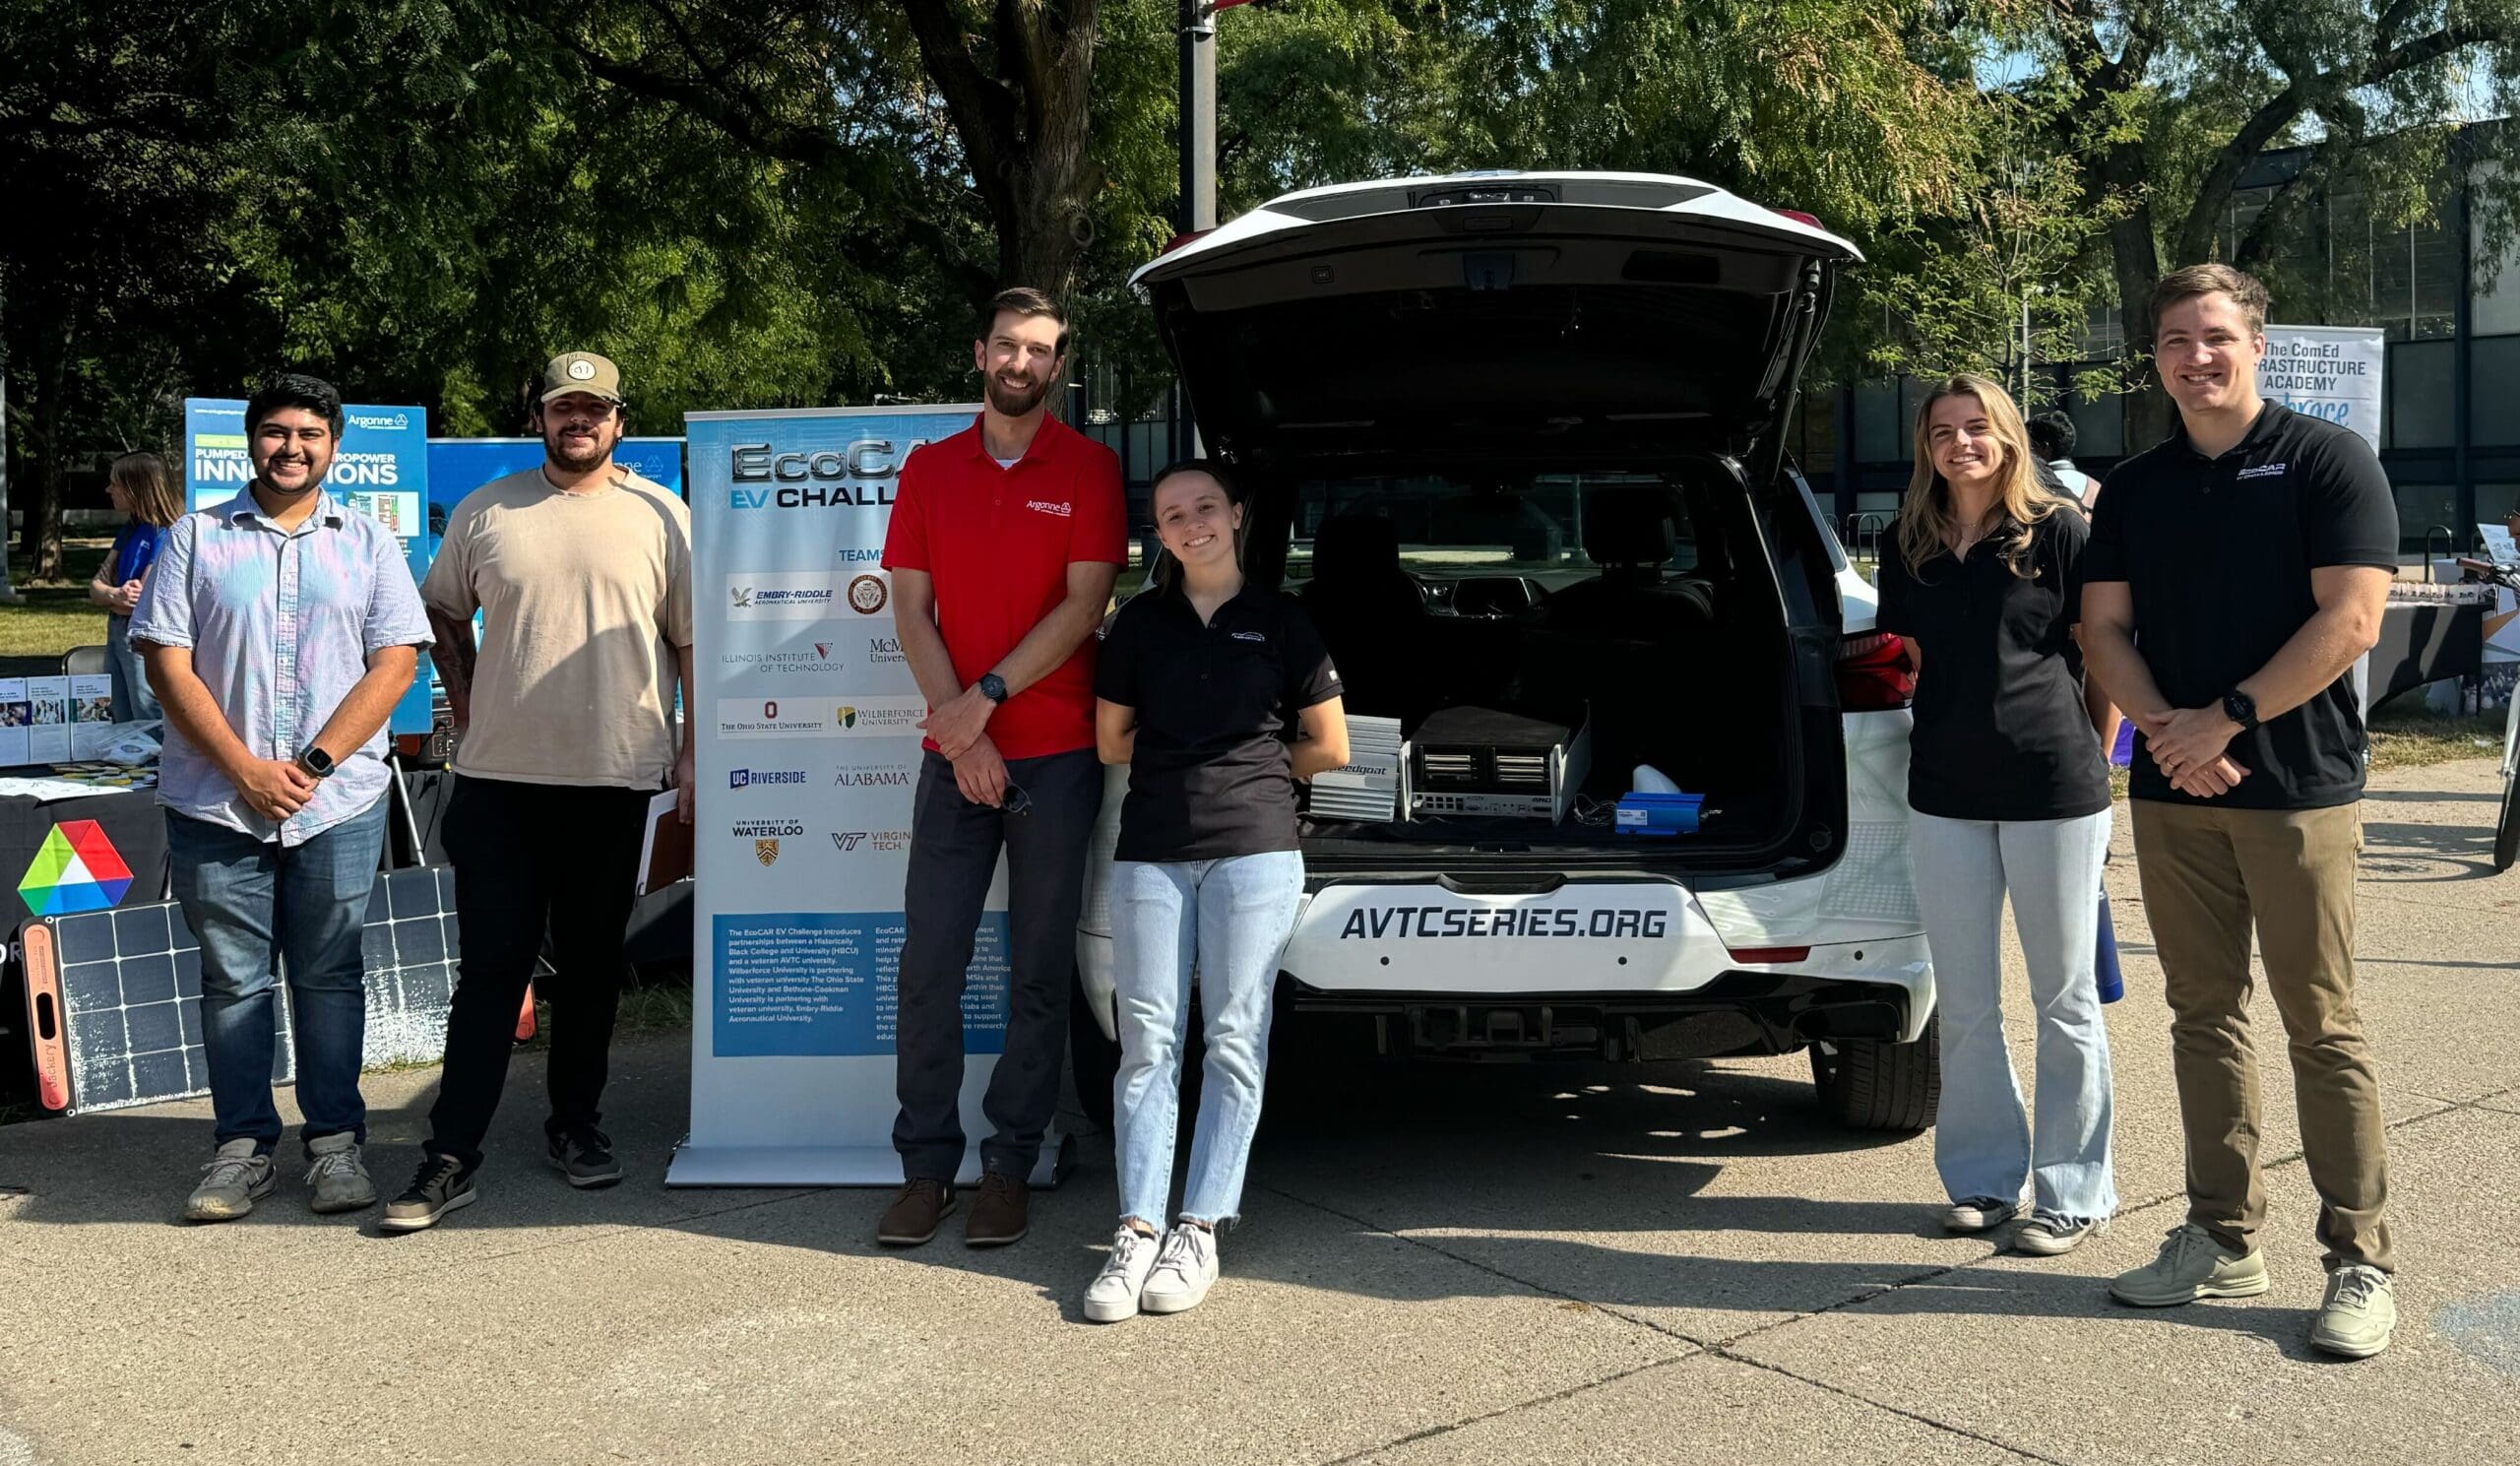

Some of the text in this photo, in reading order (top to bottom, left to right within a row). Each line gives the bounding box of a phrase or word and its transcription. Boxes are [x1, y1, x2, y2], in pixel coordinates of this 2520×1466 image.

[2264, 343, 2339, 358] The ComEd
[2258, 358, 2366, 375] RASTRUCTURE
[2264, 375, 2337, 391] ACADEMY
[2284, 392, 2349, 426] brace
[347, 414, 394, 428] Argonne
[195, 448, 396, 464] PUMPED ROPOWER
[730, 486, 895, 509] EV CHALL
[1026, 500, 1060, 511] Argonne
[756, 589, 834, 600] EMBRY-RIDDLE
[722, 653, 816, 664] ILLINOIS INSTITUTE
[870, 653, 907, 664] Univers
[760, 663, 845, 673] OF TECHNOLOGY
[857, 709, 924, 720] WILBERFORCE
[861, 718, 911, 727] UNIVERSITY
[732, 770, 807, 786] UC RIVERSIDE
[835, 772, 909, 787] ALABAMA
[732, 826, 803, 837] WATERLOO
[831, 830, 911, 851] VT VIRGIN
[1340, 907, 1667, 939] AVTCSERIES.ORG
[728, 938, 774, 947] partnerships
[814, 937, 853, 946] Historically
[750, 947, 778, 956] College
[773, 966, 807, 975] University
[817, 966, 853, 975] partnering
[776, 976, 808, 985] university
[47, 1044, 58, 1088] Jackery
